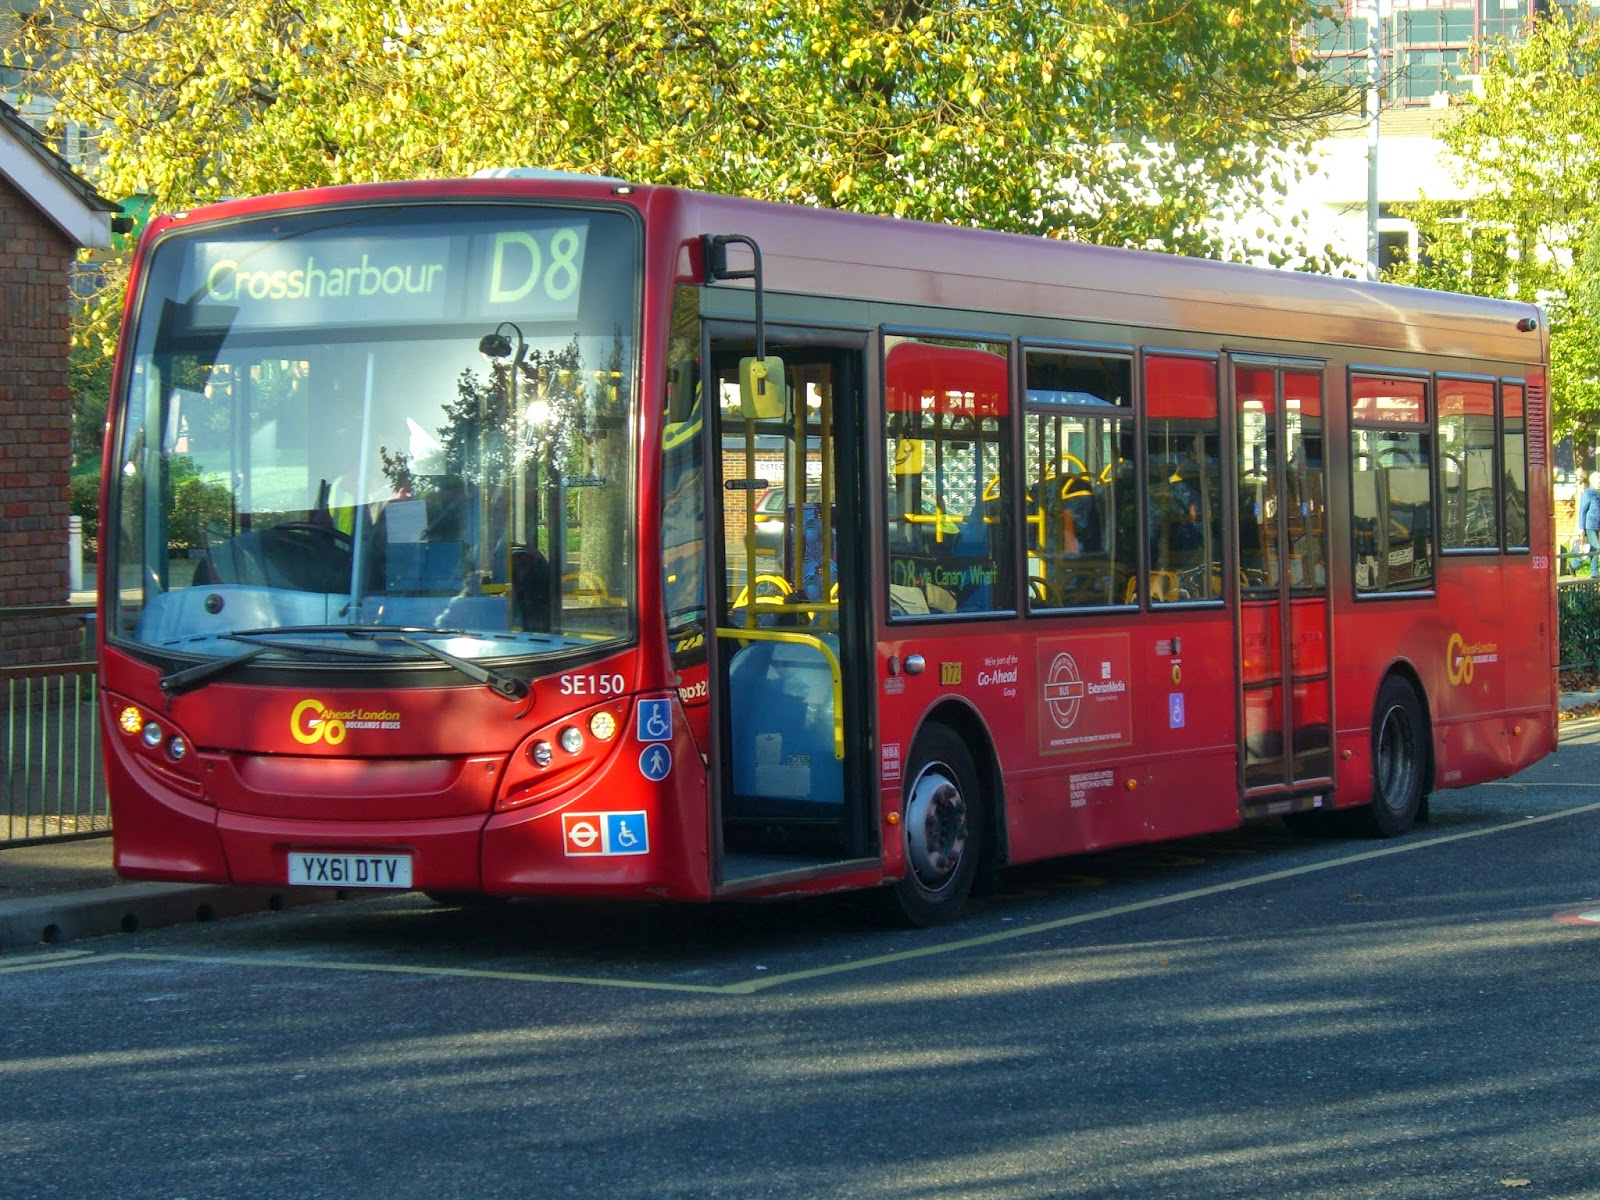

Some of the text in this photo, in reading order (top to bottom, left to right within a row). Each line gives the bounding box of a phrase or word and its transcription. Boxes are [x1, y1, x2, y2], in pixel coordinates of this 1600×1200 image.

[207, 254, 443, 301] Crossharbour
[489, 228, 580, 303] D8
[893, 559, 915, 587] D8
[934, 564, 966, 591] Canary
[1447, 632, 1474, 686] Go
[560, 674, 625, 695] SE150
[945, 665, 960, 682] 172
[978, 667, 1018, 686] Go-Ahead
[1059, 686, 1070, 696] BUS
[290, 699, 401, 746] Go Ahead-London
[345, 721, 401, 730] DOCKLANDS BUSES
[303, 858, 397, 882] YX61 DTV
